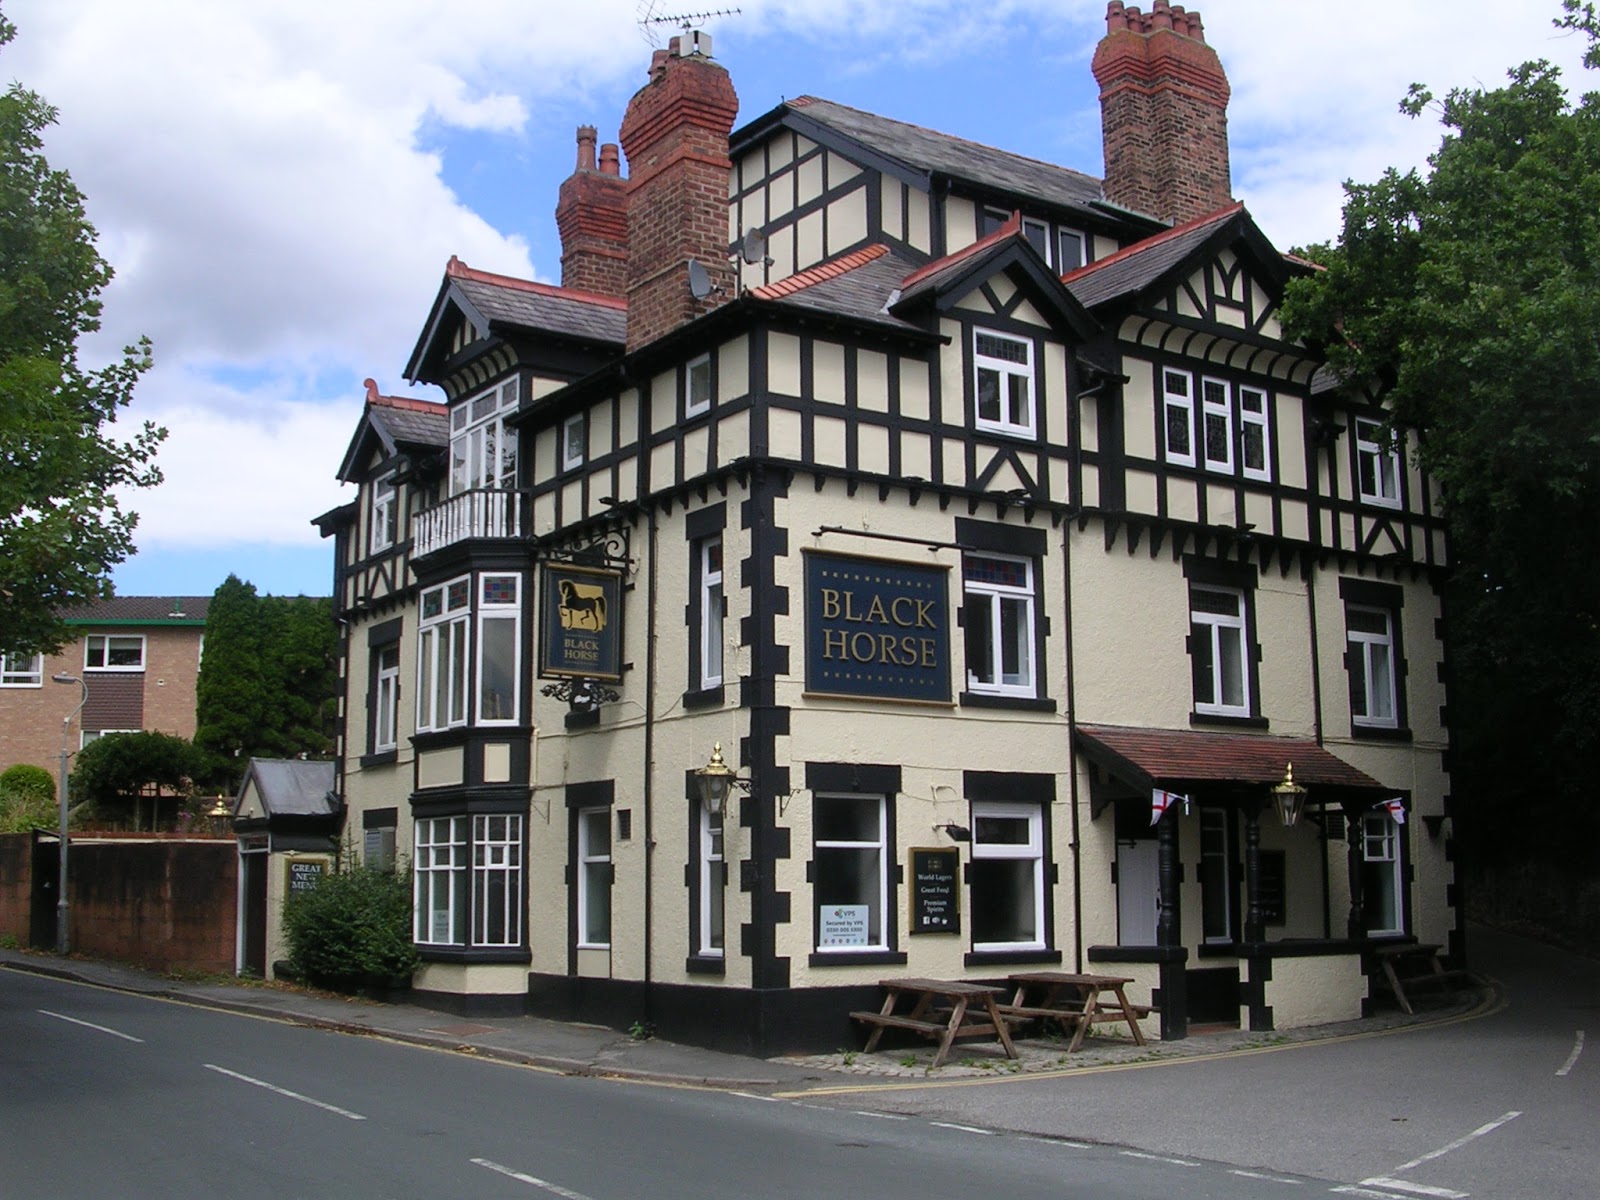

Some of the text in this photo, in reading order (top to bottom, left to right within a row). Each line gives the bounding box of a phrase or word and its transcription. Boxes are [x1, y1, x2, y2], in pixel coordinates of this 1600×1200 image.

[821, 588, 937, 629] BLACK
[564, 638, 600, 651] BLACK
[822, 628, 937, 668] HORSE
[564, 649, 599, 661] HORSE
[291, 864, 321, 872] GREAT
[917, 873, 953, 882] World Lagers
[920, 886, 936, 894] Great
[923, 899, 948, 907] Premium
[926, 906, 945, 915] Spirits
